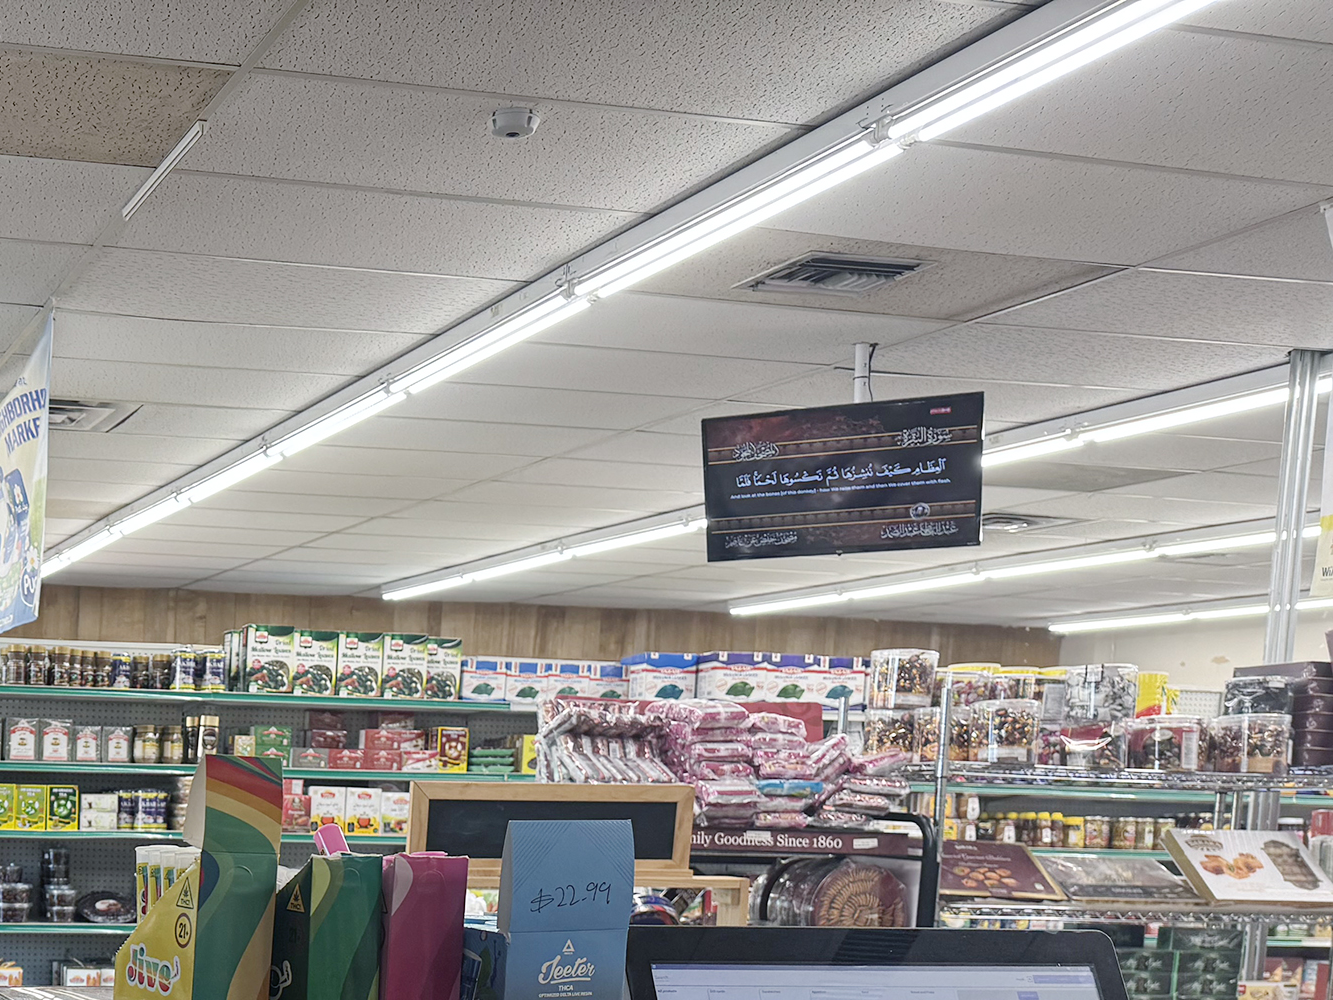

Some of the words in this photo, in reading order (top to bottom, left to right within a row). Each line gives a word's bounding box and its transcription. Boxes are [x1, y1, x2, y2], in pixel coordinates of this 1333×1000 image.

[691, 831, 711, 847] mily
[715, 832, 774, 847] Goodness
[776, 834, 809, 847] Since
[813, 836, 842, 849] 1860
[530, 882, 611, 913] $22.99
[538, 955, 596, 985] Jeeter
